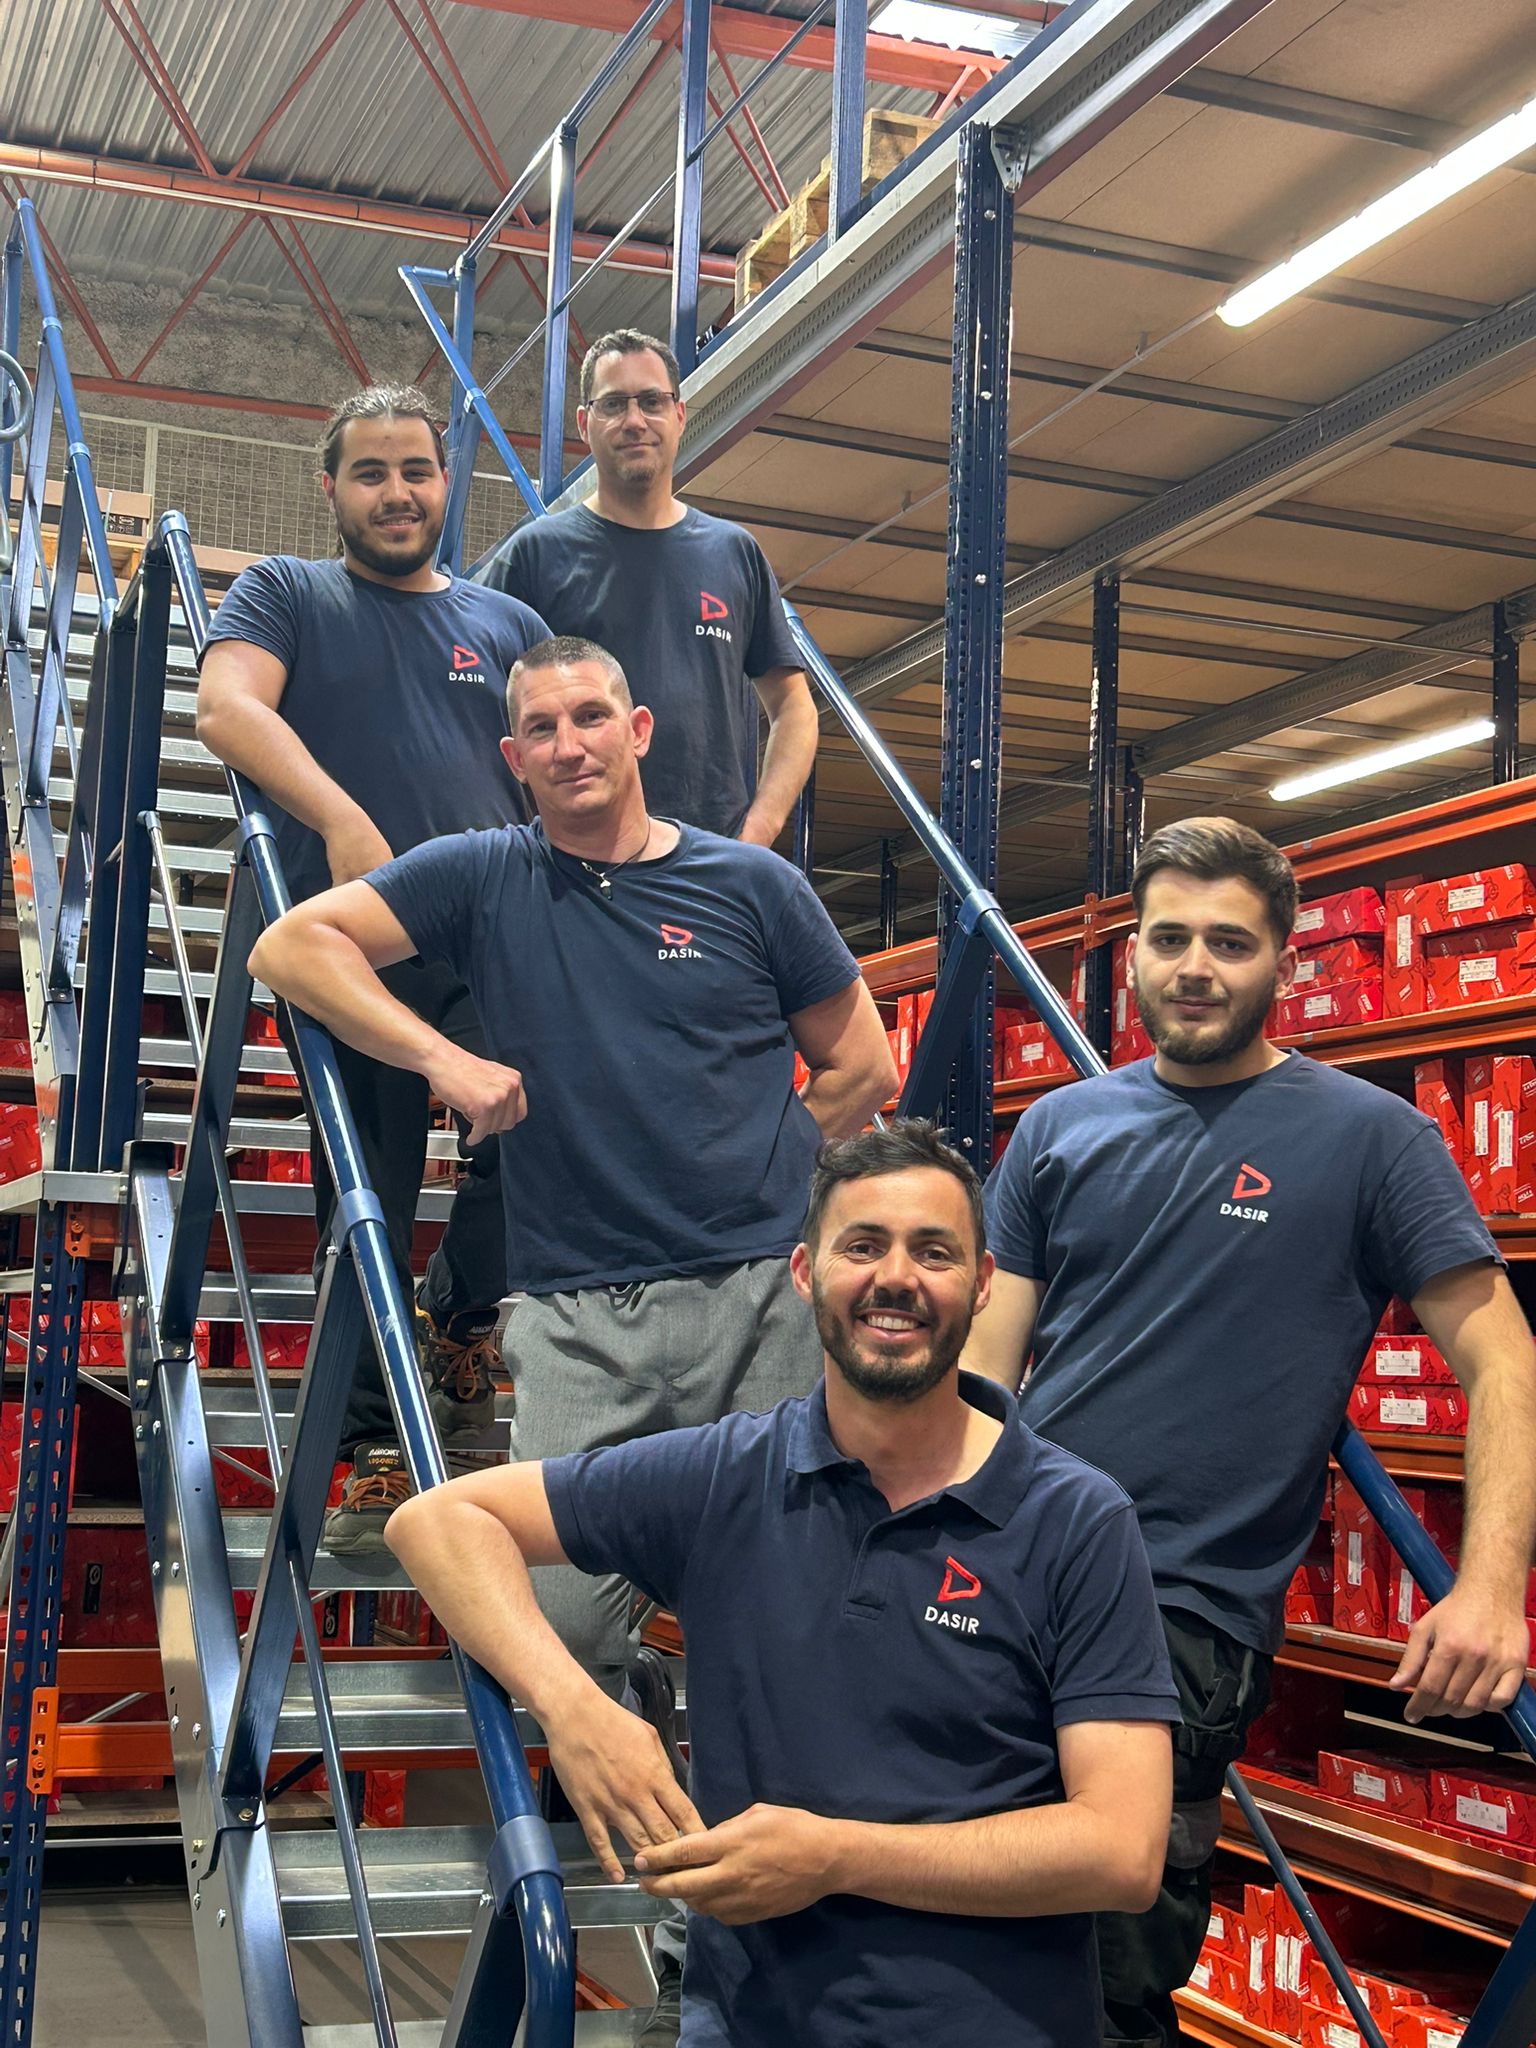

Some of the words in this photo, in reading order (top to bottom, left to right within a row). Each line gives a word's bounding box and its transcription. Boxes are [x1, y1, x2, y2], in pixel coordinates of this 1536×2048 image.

[695, 624, 732, 643] DASIR
[448, 671, 485, 684] DASIR
[658, 948, 702, 960] DASIR
[1220, 1202, 1269, 1223] DASIR
[924, 1605, 980, 1636] DASIR
